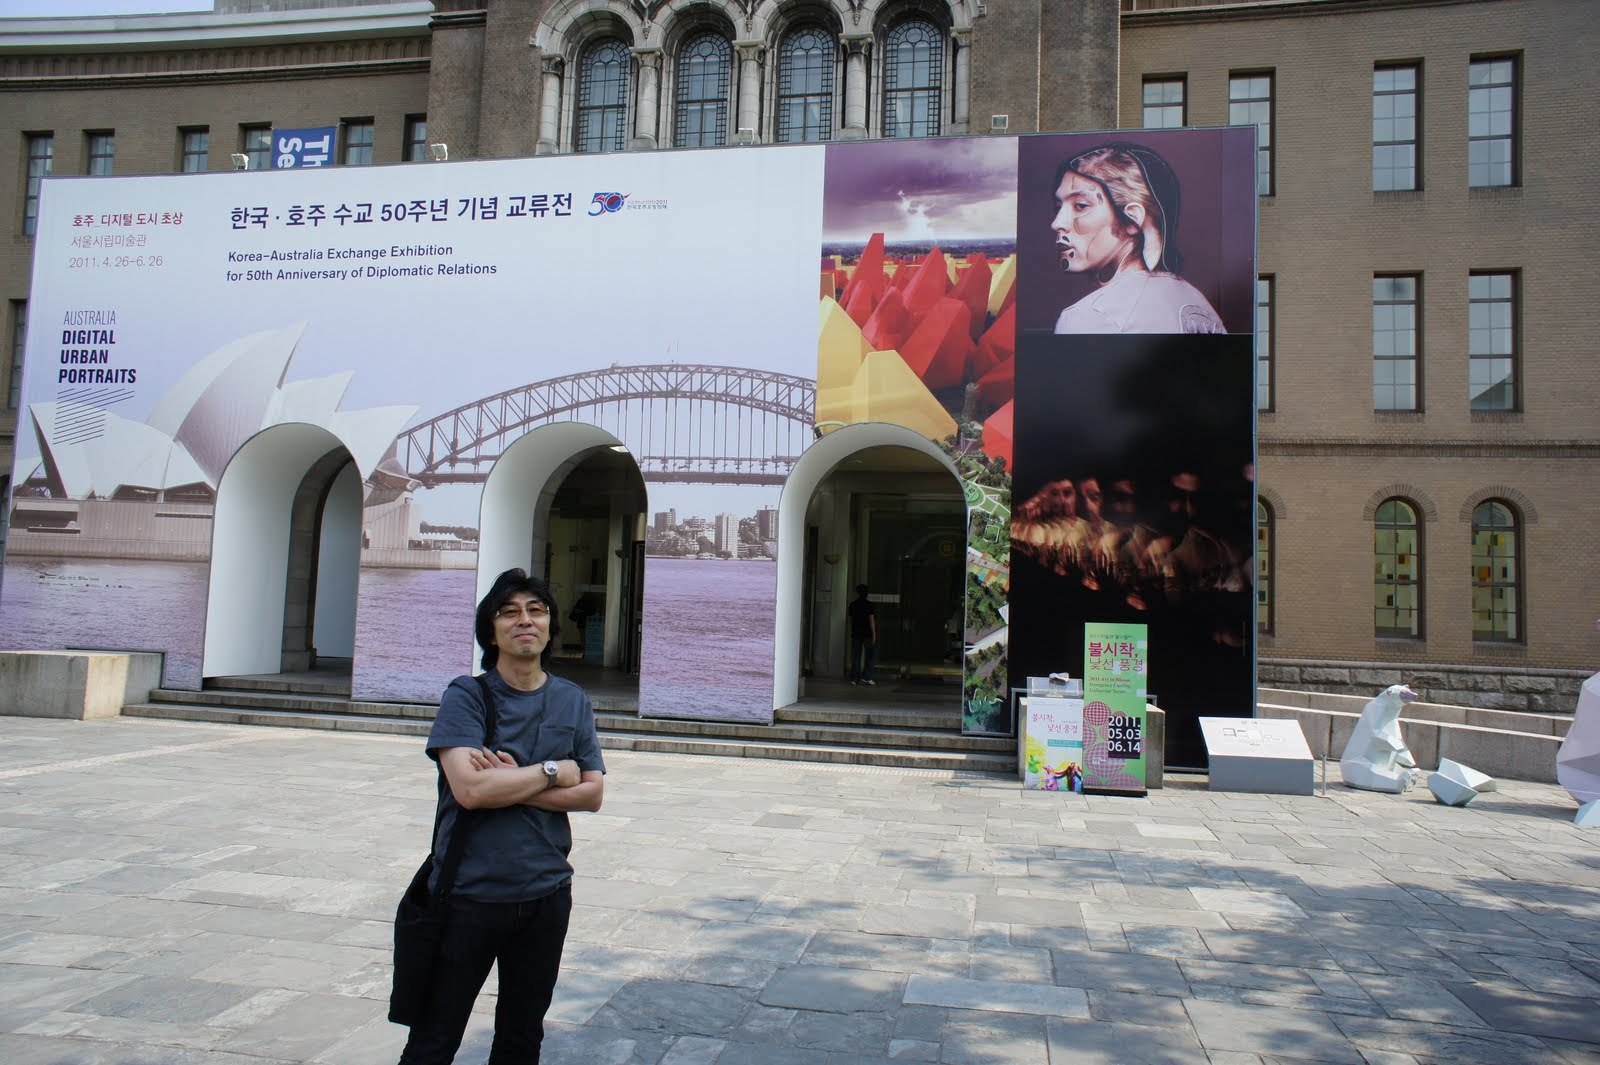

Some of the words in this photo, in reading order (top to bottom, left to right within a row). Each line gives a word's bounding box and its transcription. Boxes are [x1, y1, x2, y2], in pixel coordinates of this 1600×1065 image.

[333, 203, 373, 226] 수교
[380, 200, 449, 224] 50주년
[457, 196, 499, 221] 기념
[506, 192, 573, 218] 교류전
[136, 212, 158, 225] 도시
[161, 211, 184, 225] 초상
[71, 234, 147, 248] 서울시립미술관
[228, 249, 323, 262] Korea-Australia
[327, 247, 387, 260] Exchange
[391, 244, 453, 257] Exhibition
[226, 271, 243, 281] for
[246, 269, 273, 281] 50th
[276, 267, 348, 280] Anniversary
[351, 266, 364, 278] of
[367, 265, 434, 279] Diplomatic
[437, 263, 497, 276] Relations
[63, 310, 116, 326] AUSTRALIA
[62, 329, 116, 345] DIGITAL
[60, 349, 109, 364] URBAN
[58, 368, 137, 384] PORTRAITS
[1088, 641, 1138, 658] 불시착,
[1119, 658, 1143, 672] 풍경
[1108, 715, 1141, 727] 2011.
[1108, 728, 1141, 740] 05.03
[1108, 740, 1141, 752] 06.14
